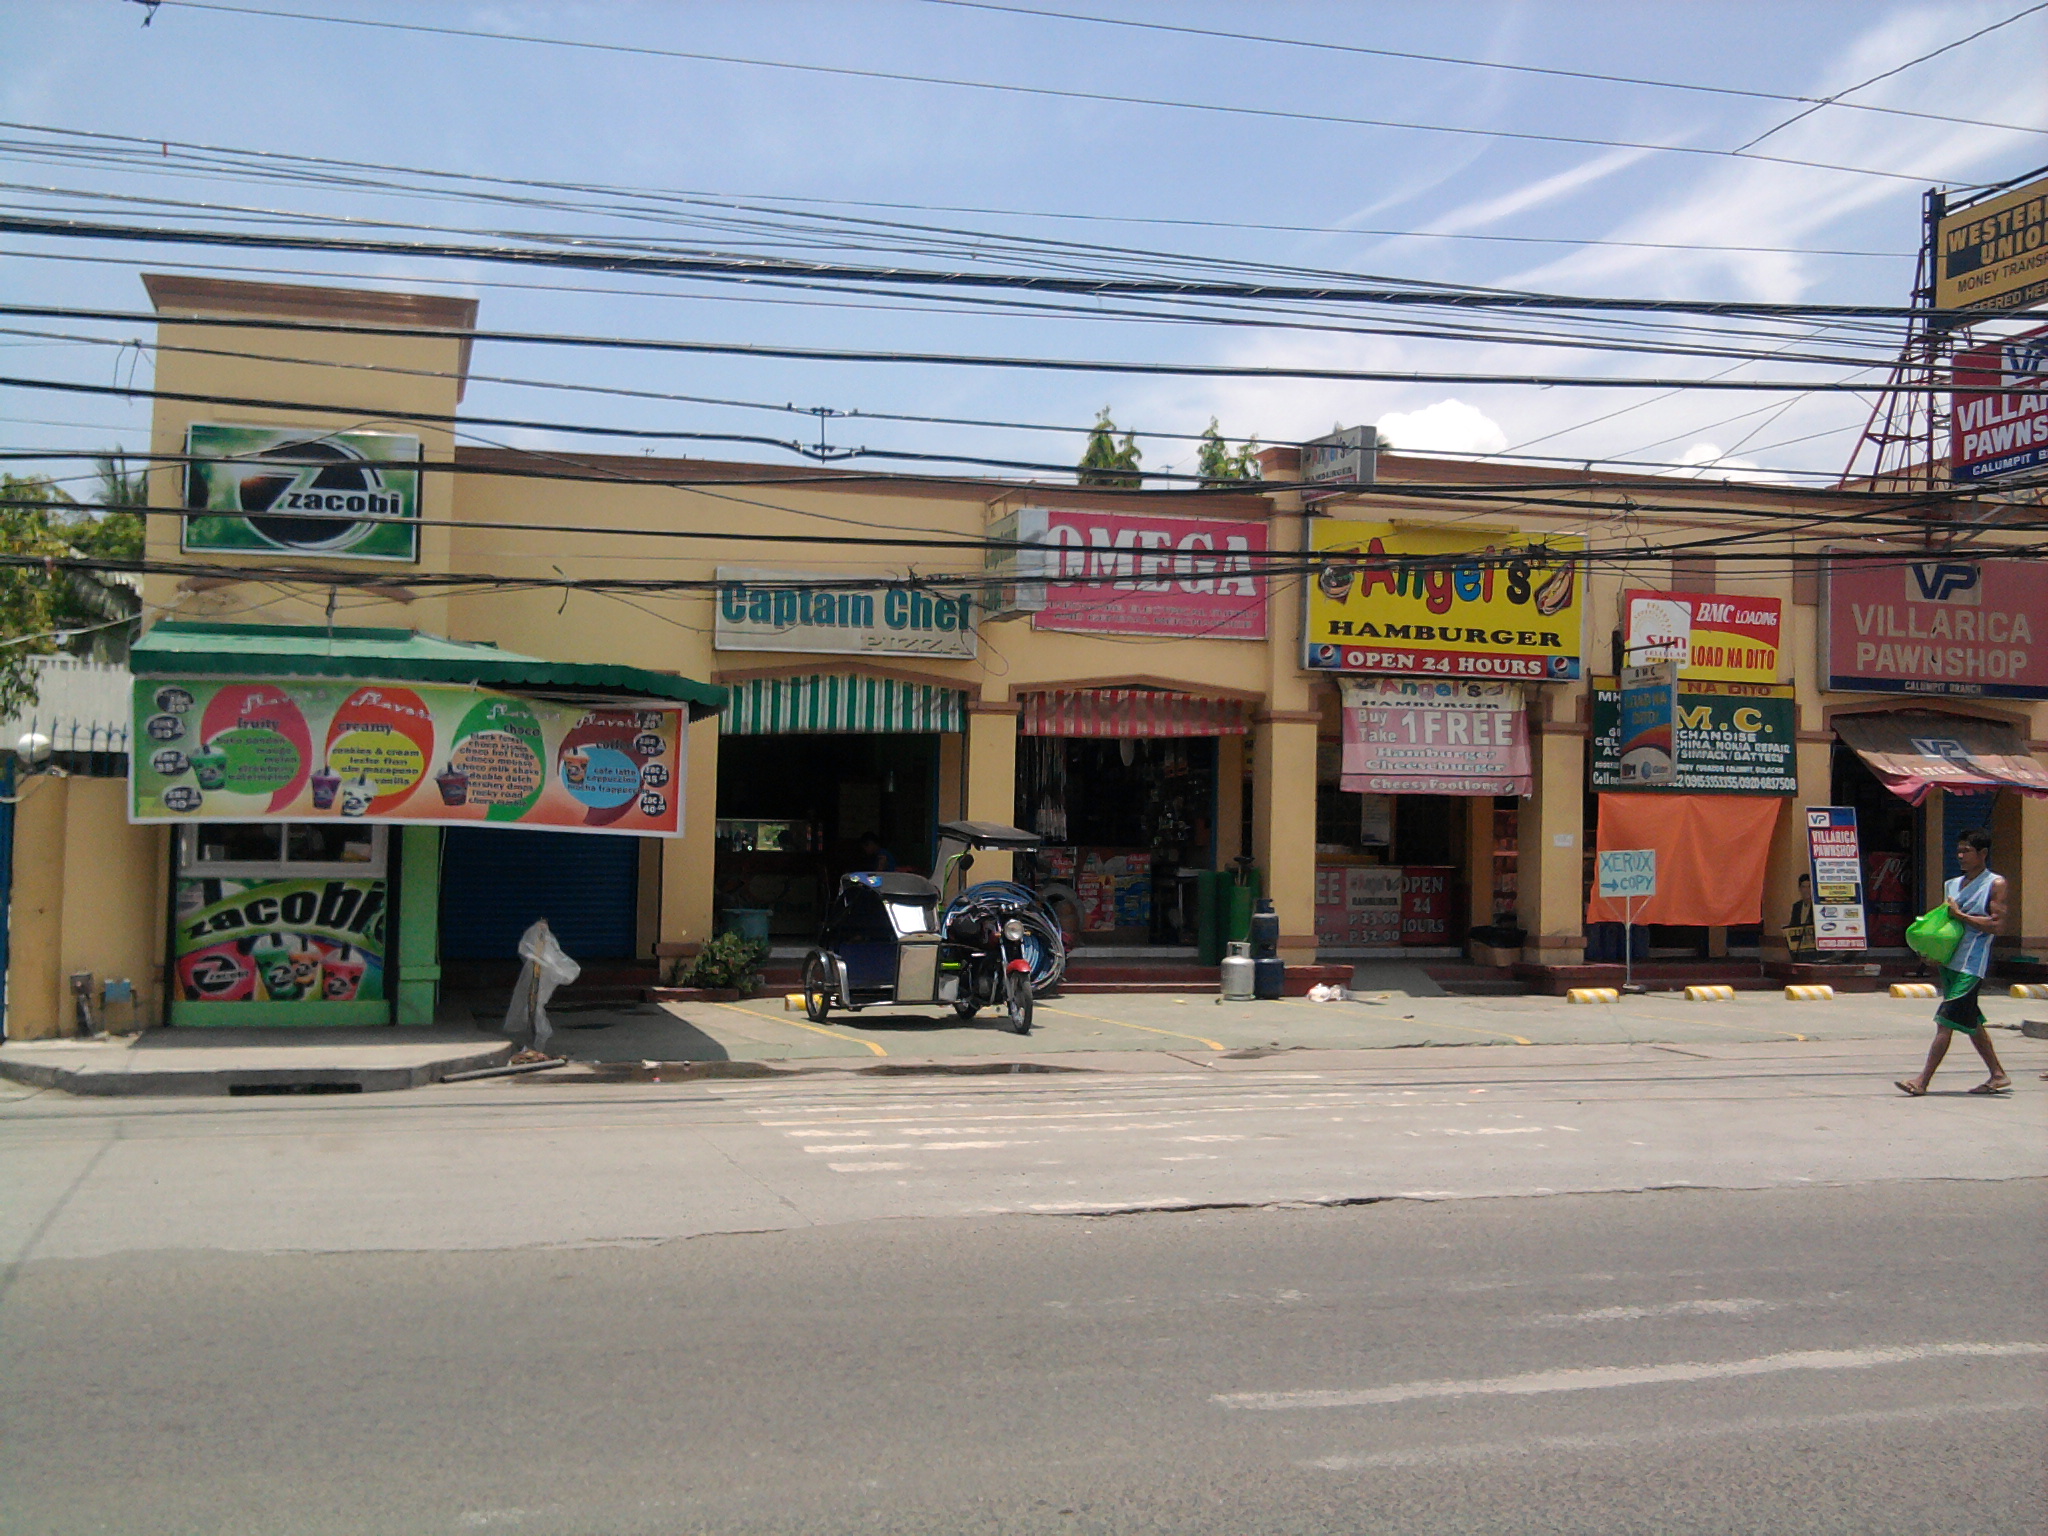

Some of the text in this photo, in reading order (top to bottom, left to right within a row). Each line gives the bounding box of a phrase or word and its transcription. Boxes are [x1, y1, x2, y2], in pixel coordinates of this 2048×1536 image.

[1948, 194, 2048, 253] WESTER
[1981, 220, 2048, 265] UNIO
[1958, 269, 1998, 292] MONEY
[1972, 453, 2032, 476] CALUMPIT
[287, 492, 400, 514] zacobi
[1046, 525, 1257, 596] OMEGA
[1912, 564, 1977, 600] VP
[721, 581, 971, 632] Captain Chef
[1697, 602, 1778, 625] BMC LOADING
[1328, 620, 1562, 647] HAMBURGER
[1852, 603, 2032, 644] VILLARICA
[1347, 651, 1541, 675] OPEN 24 HOURS
[1691, 645, 1775, 670] LOAD NA DITO
[1857, 642, 2027, 678] PAWNSHOP
[1379, 680, 1481, 699] Angel's
[1687, 683, 1772, 696] NA DITO
[237, 716, 279, 732] fruity
[1358, 709, 1387, 724] Buy
[338, 722, 393, 736] creamy
[503, 722, 541, 737] choco
[1359, 727, 1397, 742] Take
[1376, 747, 1496, 761] Hamburger
[1755, 743, 1790, 754] REPAIR
[1365, 759, 1506, 774] Cheeseburger
[1811, 830, 1856, 844] VILLARICA
[1813, 844, 1857, 857] PAWNSHOP
